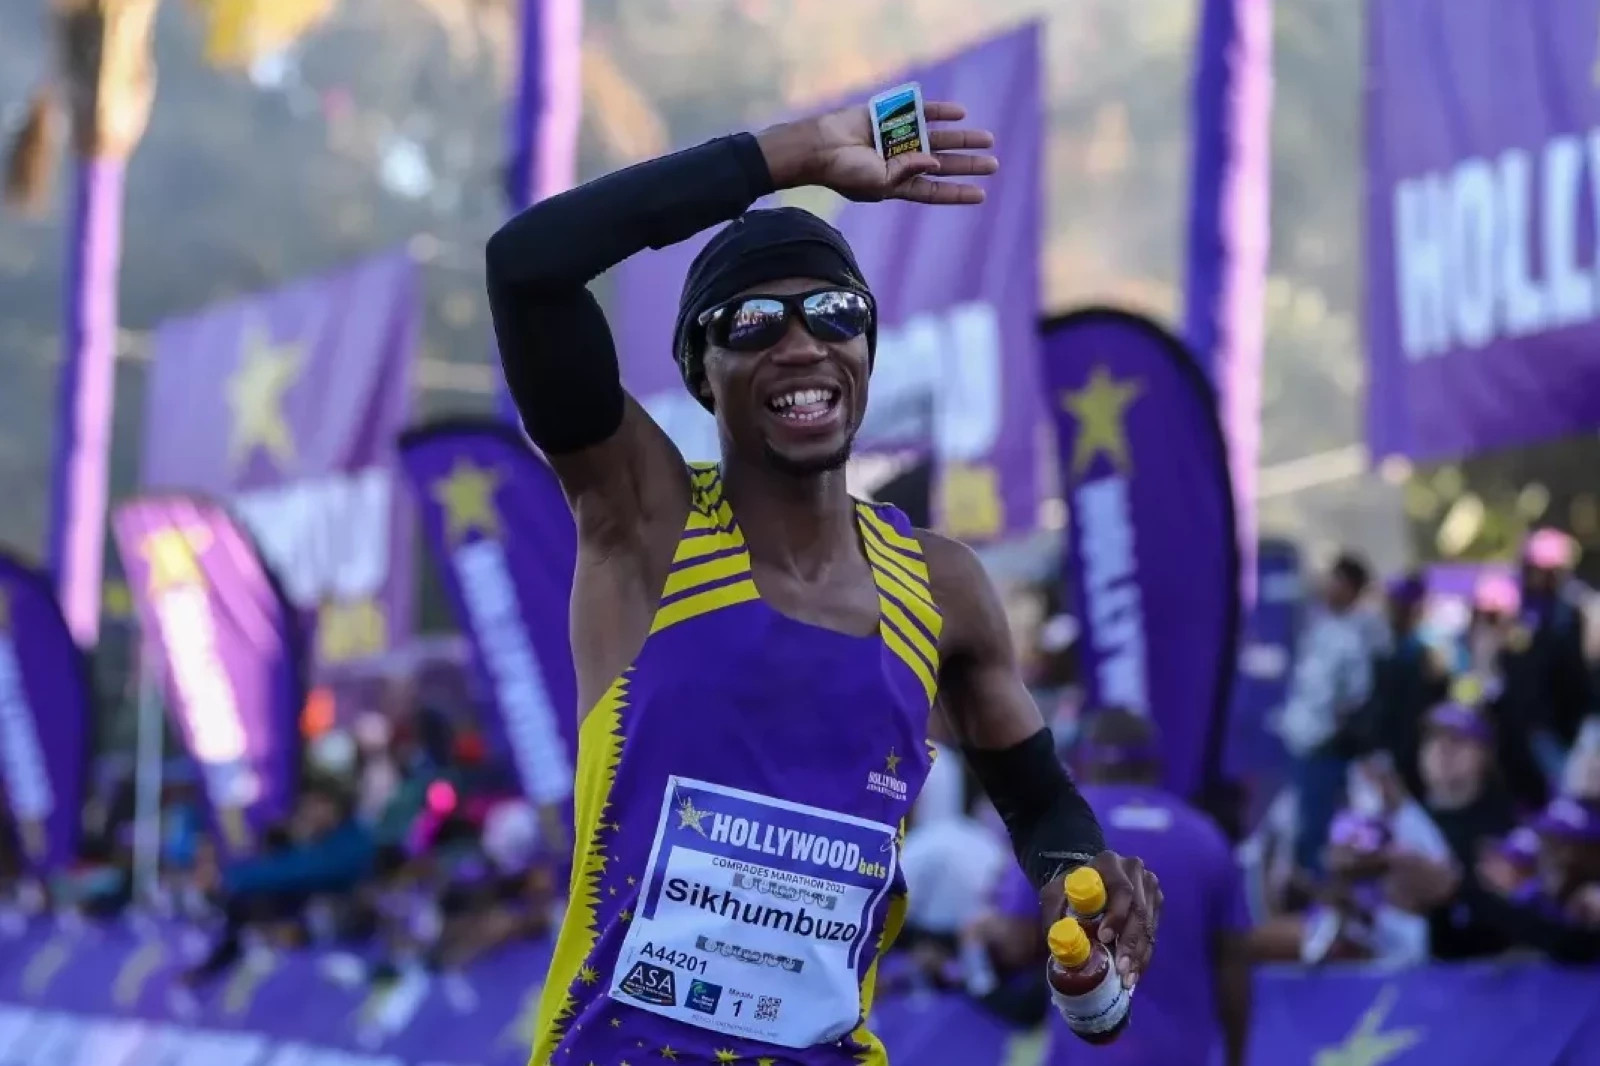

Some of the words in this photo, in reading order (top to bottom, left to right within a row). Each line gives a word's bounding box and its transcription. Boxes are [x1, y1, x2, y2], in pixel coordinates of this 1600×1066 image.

[1393, 124, 1600, 363] HOLL
[712, 857, 769, 880] COMRADES
[770, 869, 824, 892] MARATHON
[665, 877, 857, 943] Sikhumbuzo
[640, 941, 707, 975] A44201
[629, 967, 673, 993] ASA
[732, 1000, 743, 1018] 1
